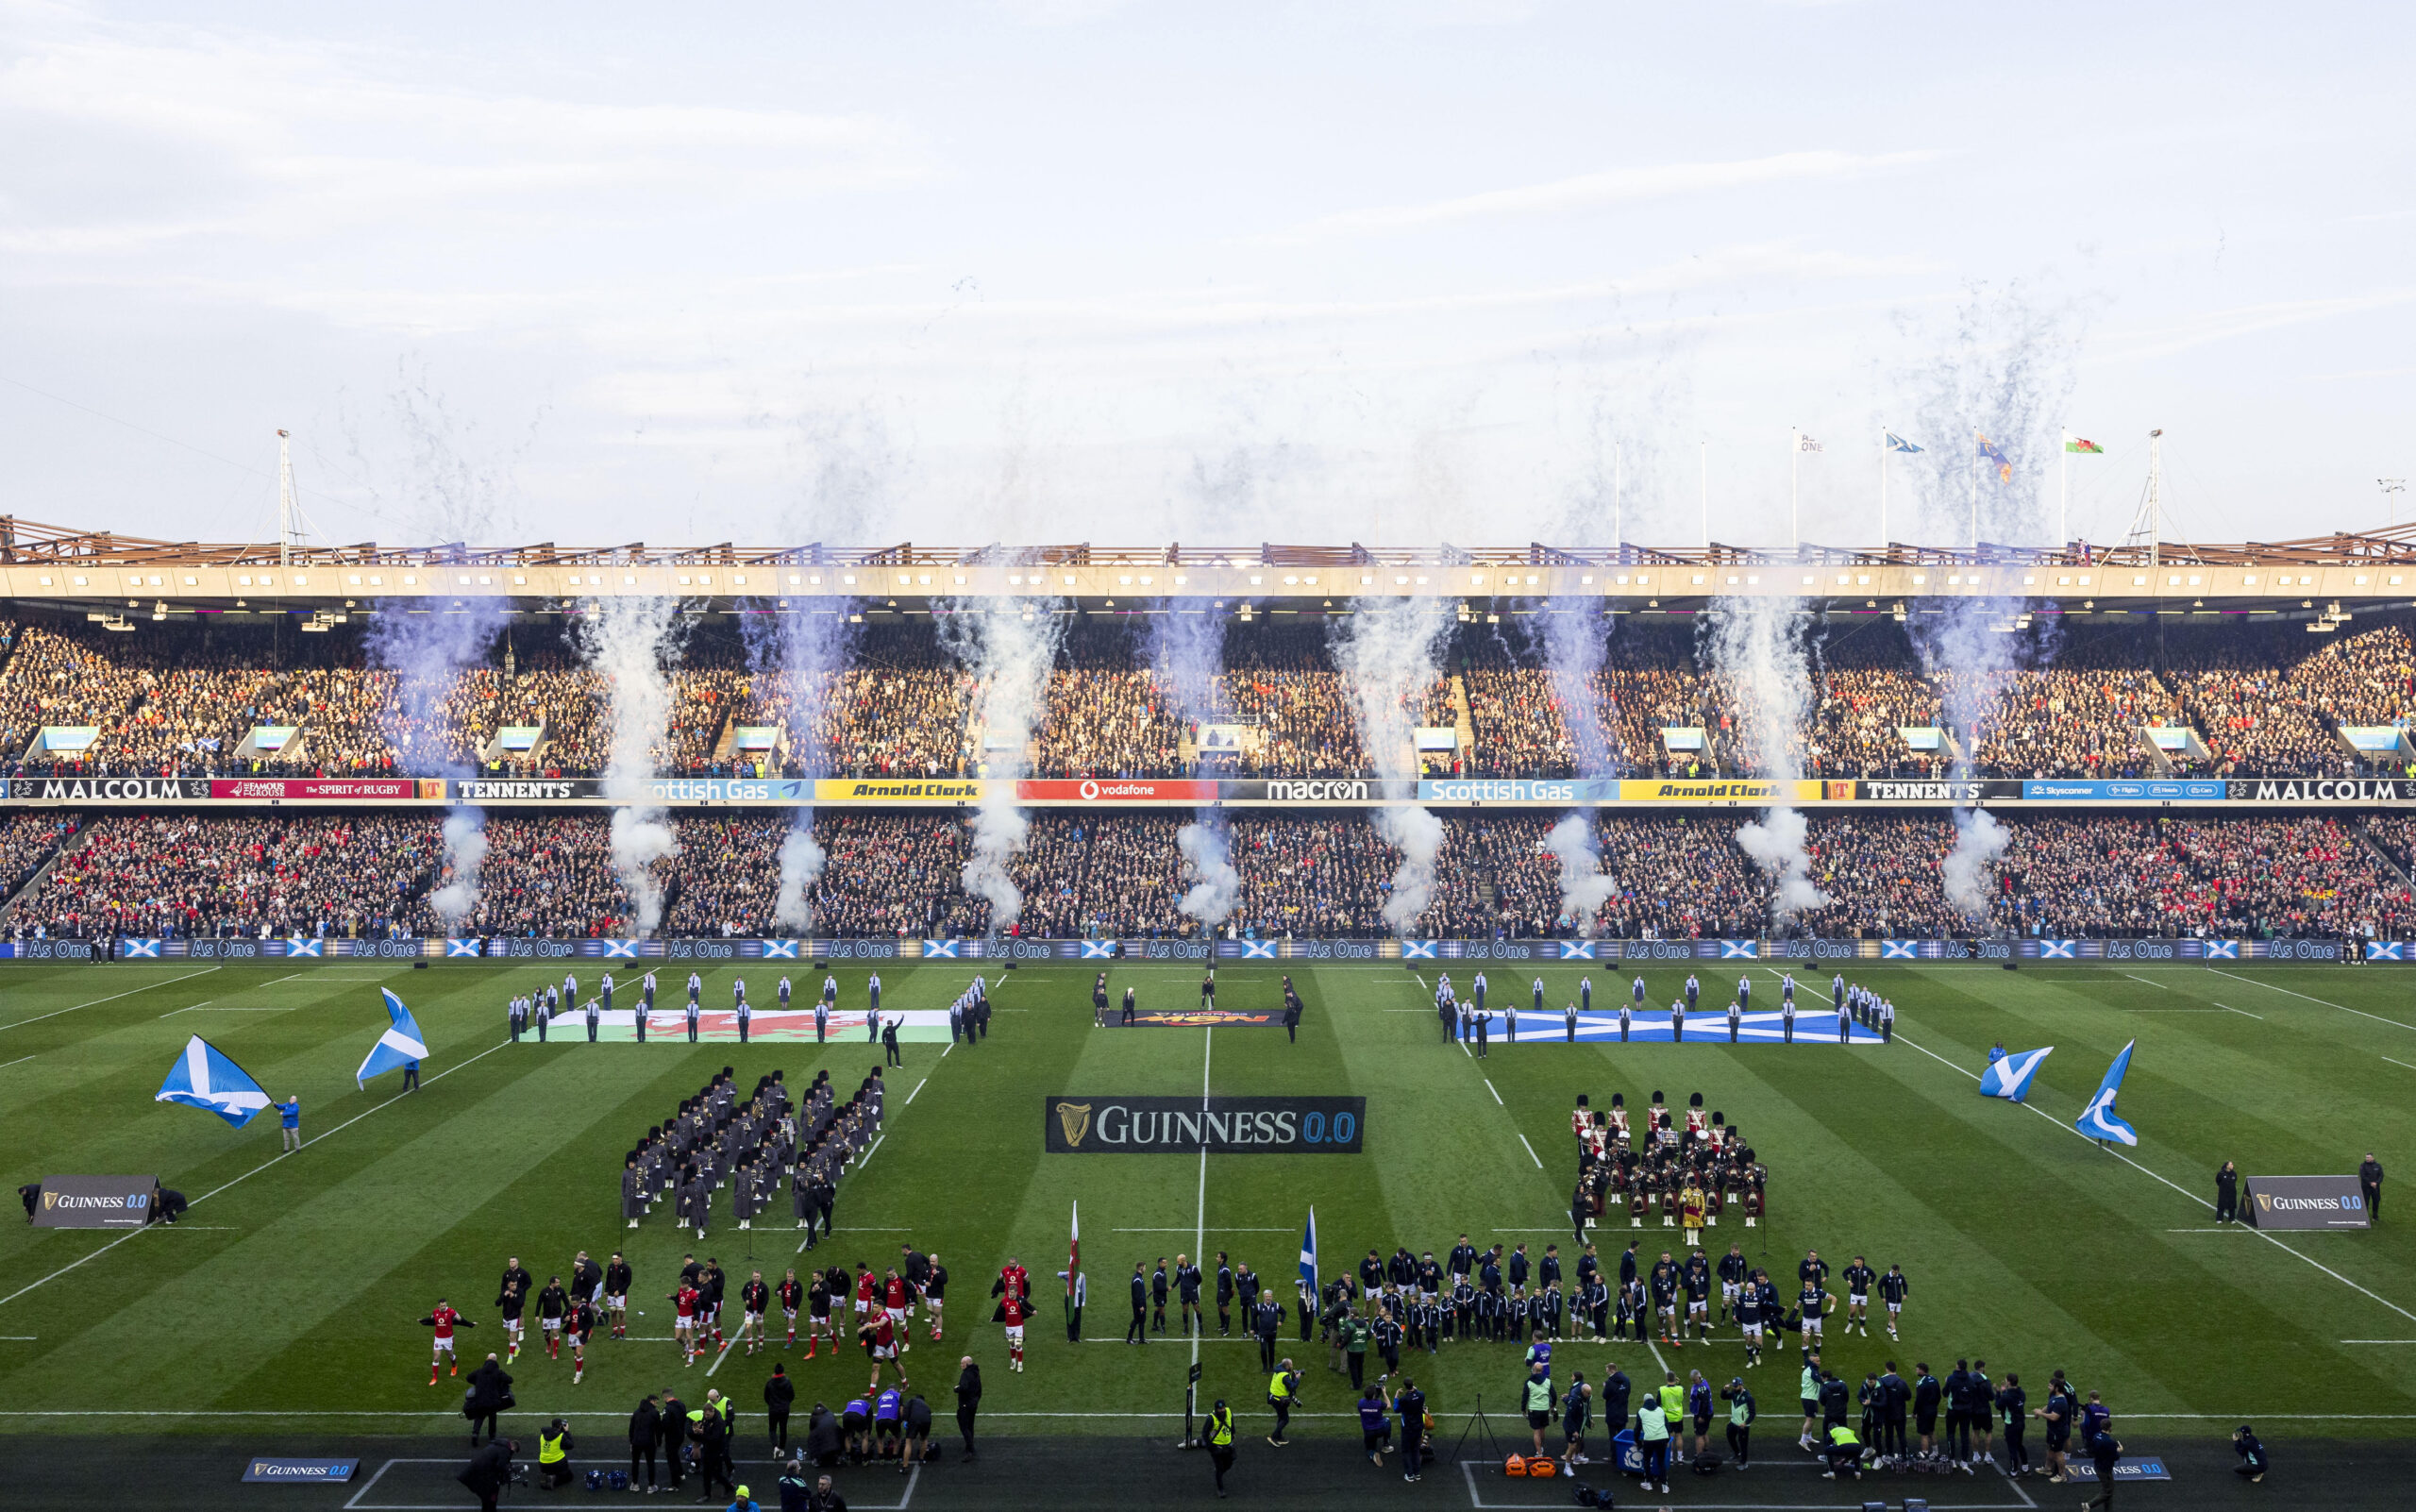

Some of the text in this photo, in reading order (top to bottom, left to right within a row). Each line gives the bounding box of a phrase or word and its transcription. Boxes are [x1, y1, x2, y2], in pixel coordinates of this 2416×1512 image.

[42, 780, 182, 799] MALCOLM
[319, 784, 354, 795] SPIRIT
[354, 786, 362, 796] of
[363, 784, 401, 795] RUGBY
[427, 781, 440, 797] T
[726, 780, 769, 800] Gas
[852, 783, 978, 797] Arnold Clark
[1101, 783, 1155, 796] vodafone
[1267, 781, 1367, 800] macron
[1432, 781, 1573, 800] Scottish Gas
[1657, 784, 1783, 798] Arnold Clark
[1835, 782, 1850, 798] T
[2046, 786, 2093, 796] Skyscanner
[2255, 781, 2397, 800] MALCOLM
[27, 940, 92, 958] As One
[192, 940, 256, 957] As One
[354, 940, 417, 957] As One
[511, 940, 574, 957] As One
[669, 940, 732, 958] As One
[829, 940, 894, 958] As One
[987, 941, 1050, 959] As One
[1147, 941, 1211, 959] As One
[1308, 941, 1372, 959] As One
[1466, 941, 1530, 959] As One
[1626, 941, 1690, 959] As One
[1787, 940, 1852, 958] As One
[1946, 940, 2010, 958] As One
[2107, 940, 2173, 959] As One
[2269, 941, 2335, 959] As One
[1096, 1105, 1356, 1144] GUINNESS 0.0
[58, 1194, 147, 1208] GUINNESS 0.0
[2273, 1195, 2362, 1210] GUINNESS 0.0
[266, 1465, 349, 1476] GUINNESS 0.0
[2141, 1464, 2162, 1474] 0.0
